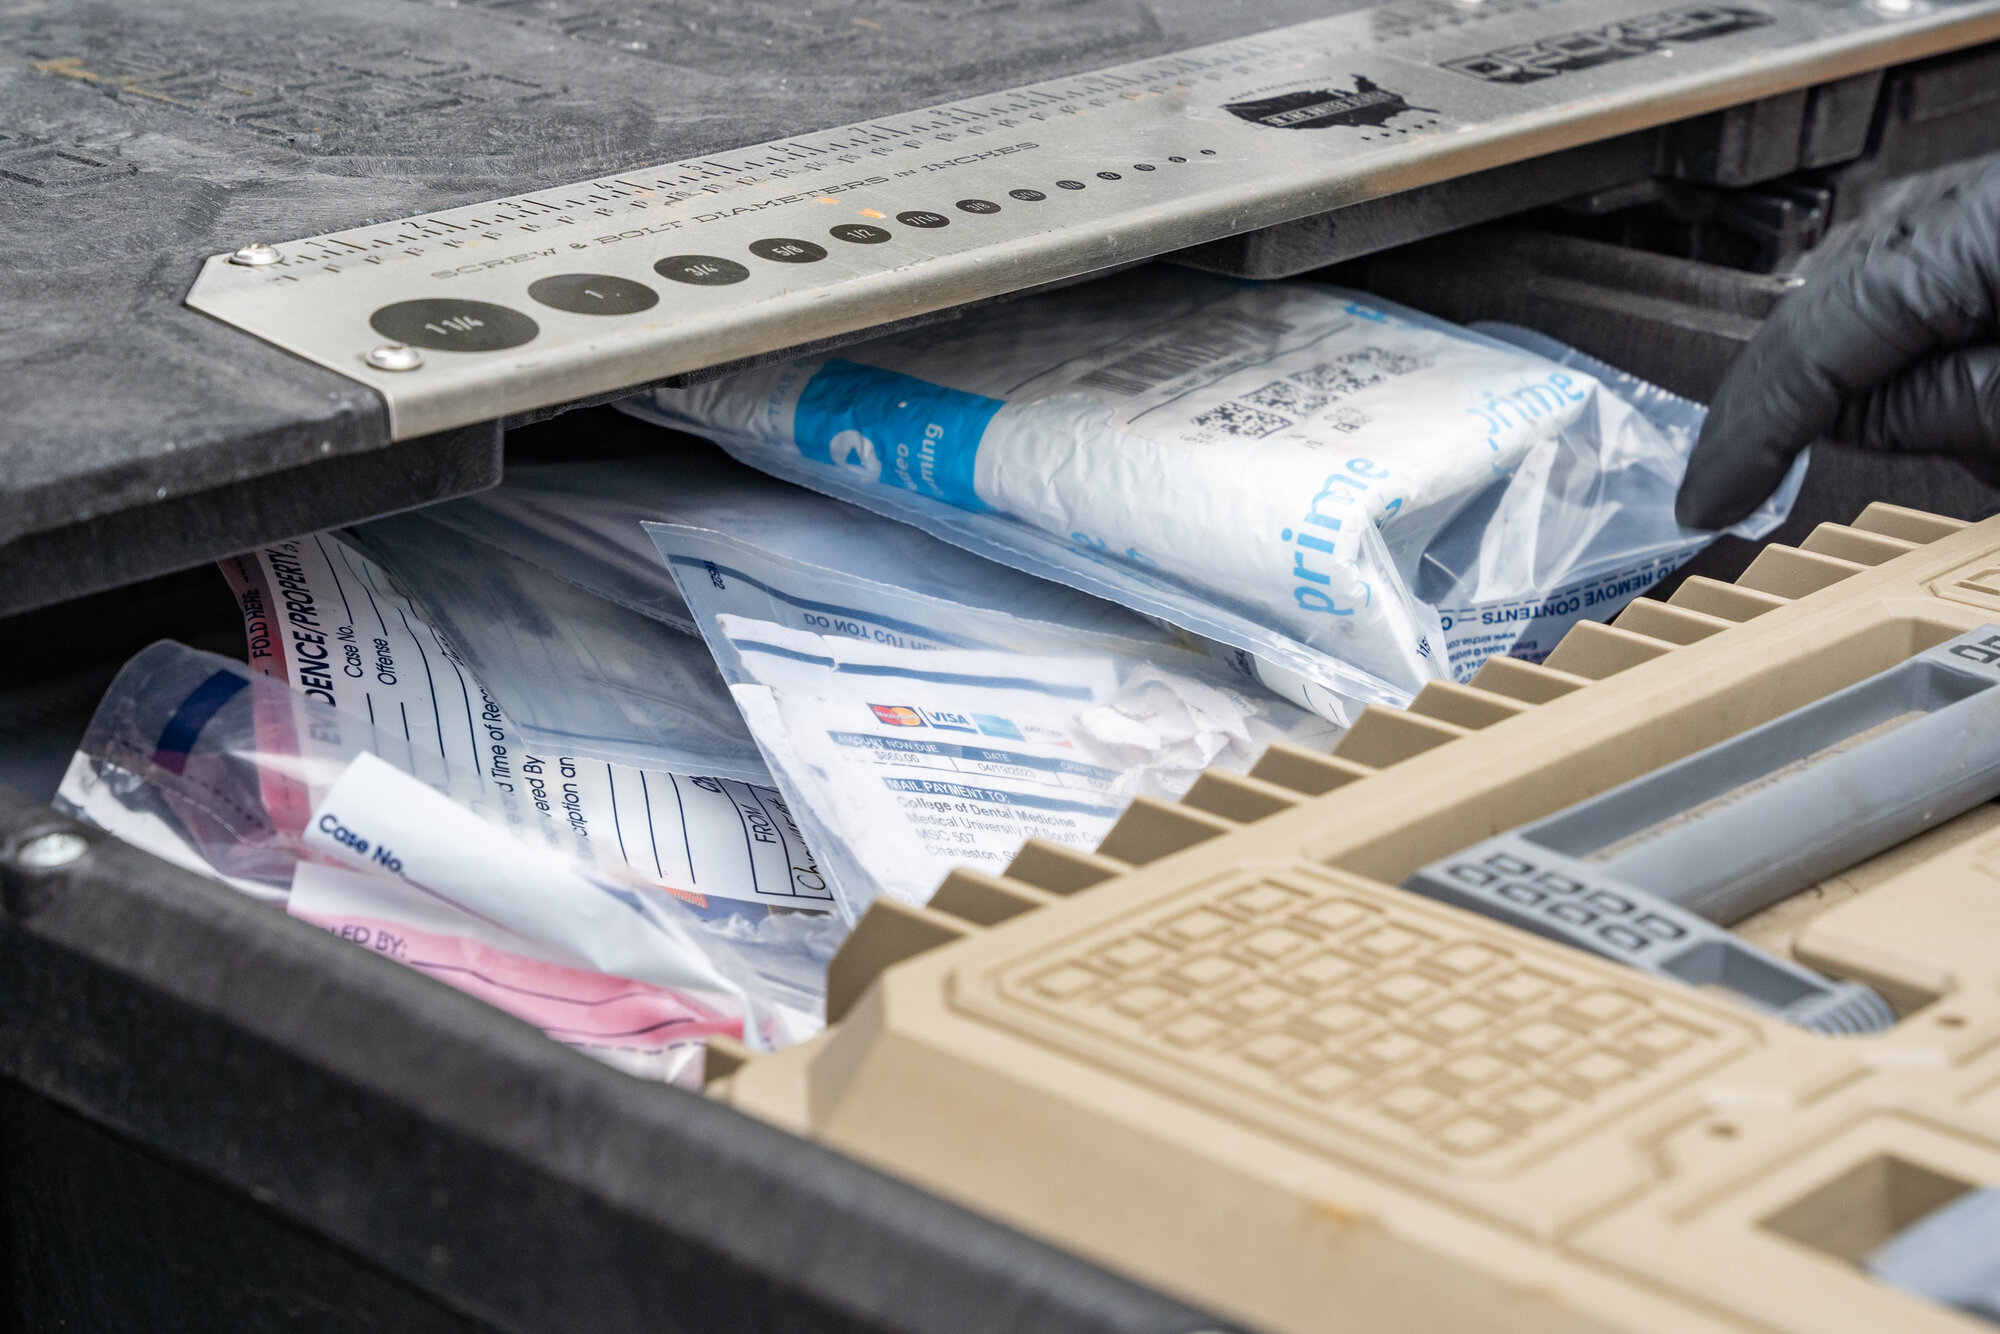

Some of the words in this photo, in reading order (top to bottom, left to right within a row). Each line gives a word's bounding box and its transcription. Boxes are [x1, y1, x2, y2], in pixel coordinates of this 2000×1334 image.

[431, 247, 557, 279] SCREW
[593, 221, 684, 245] BOLT
[692, 176, 889, 223] DIAMETERS
[921, 142, 1040, 172] INCHES
[906, 214, 940, 227] 7/16
[849, 228, 876, 240] 1/2
[772, 244, 804, 257] 5/8
[684, 263, 719, 277] 3/4
[1281, 459, 1390, 615] prime
[1585, 573, 1652, 606] REMOVE
[244, 588, 268, 622] HERE
[1482, 598, 1580, 625] CONTENTS
[250, 622, 272, 659] FOLD
[336, 624, 356, 643] No.
[344, 644, 364, 679] Case
[373, 637, 397, 686] Offense
[930, 711, 970, 726] VISA
[484, 723, 505, 742] of
[885, 740, 915, 752] NOW
[916, 743, 940, 754] DUE
[982, 751, 1011, 763] DATE
[491, 743, 512, 779] Time
[524, 754, 547, 776] By
[887, 778, 923, 793] MAIL
[924, 782, 985, 801] PAYMENT
[988, 789, 1011, 804] TO:
[740, 803, 777, 844] FROM
[897, 796, 952, 813] College
[955, 801, 969, 814] of
[972, 804, 1015, 820] Dental
[1017, 810, 1076, 828] Medicine
[905, 813, 958, 829] Medical
[962, 818, 1022, 838] University
[1024, 825, 1041, 837] Of
[1042, 827, 1080, 843] South
[915, 829, 950, 843] MSC
[952, 831, 976, 845] 507
[319, 814, 370, 855] Case
[372, 845, 405, 877] No.
[376, 930, 408, 958] BY:
